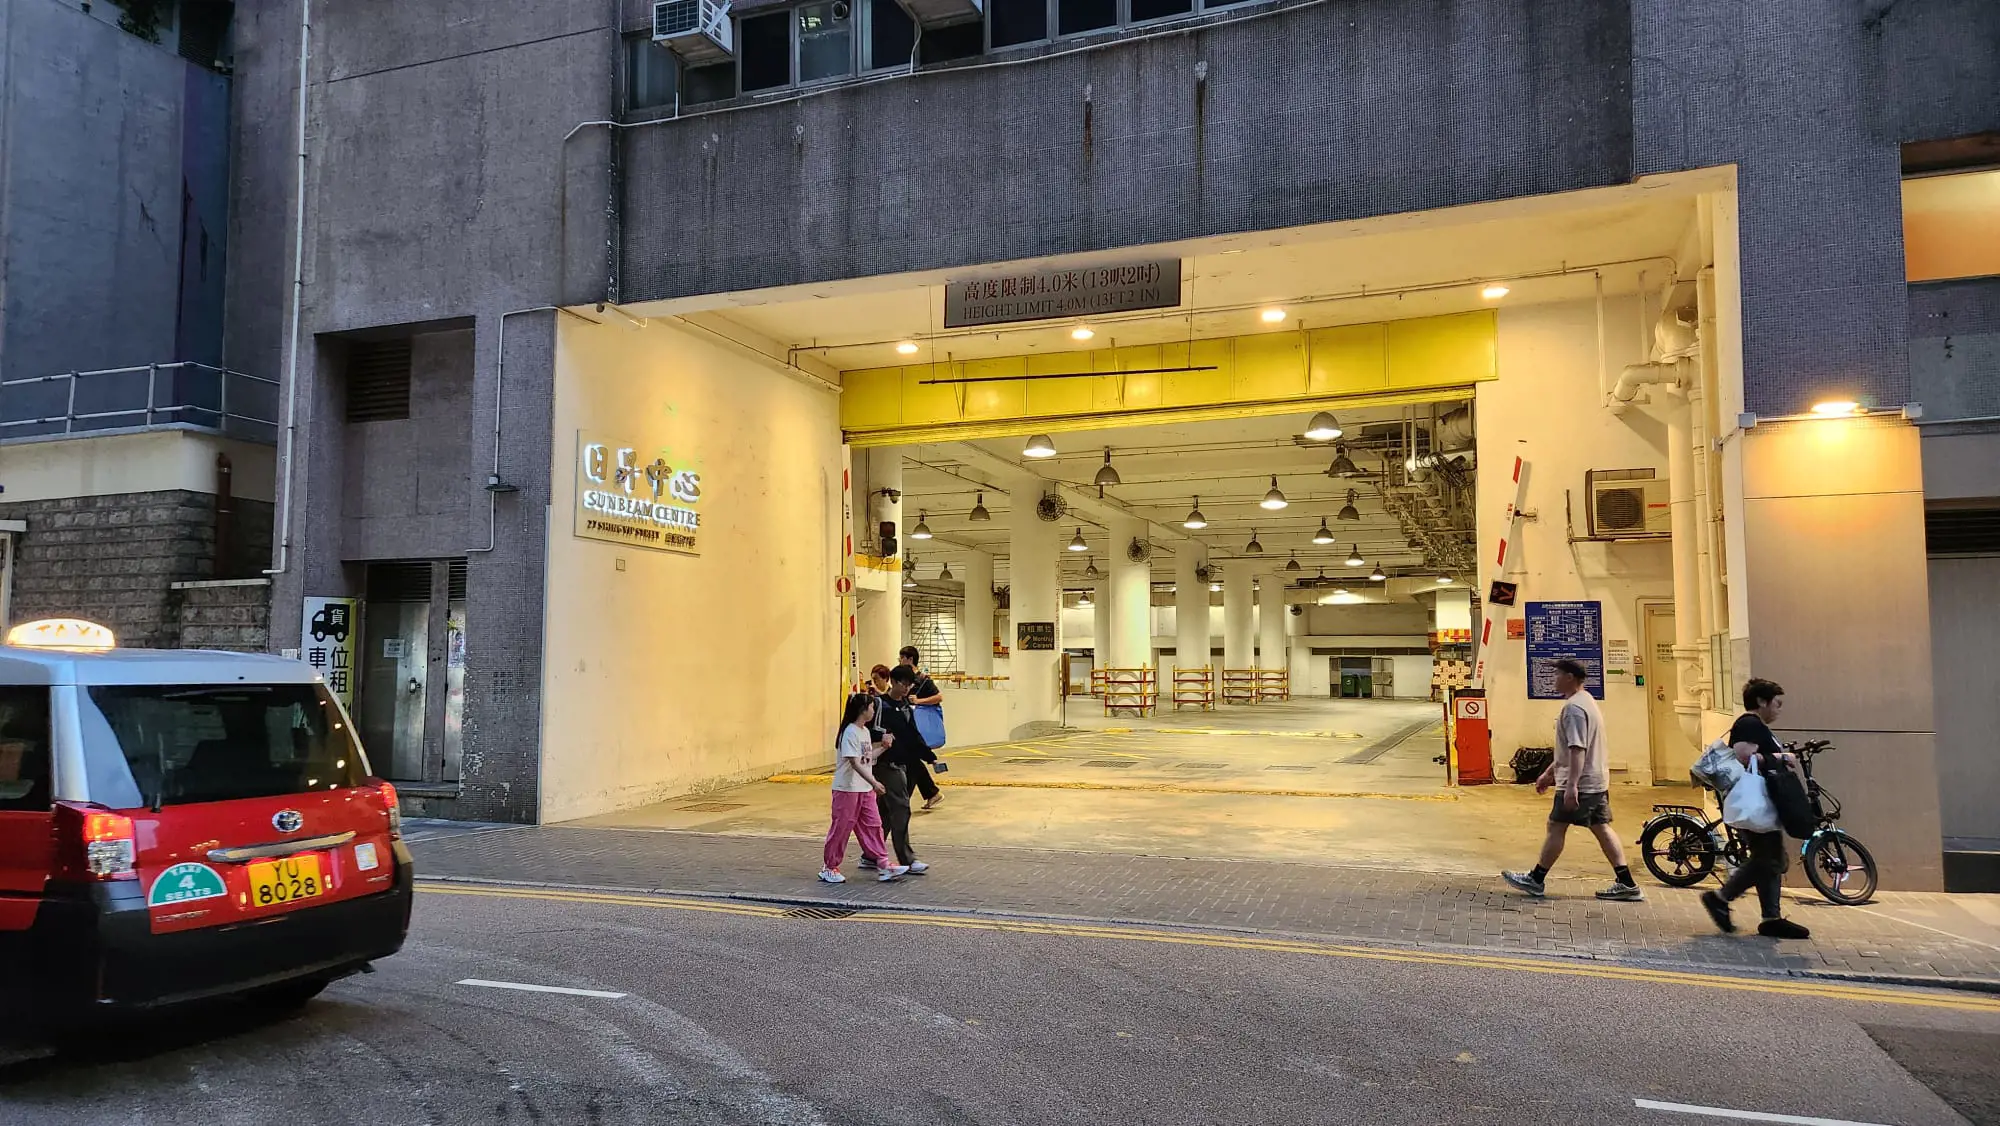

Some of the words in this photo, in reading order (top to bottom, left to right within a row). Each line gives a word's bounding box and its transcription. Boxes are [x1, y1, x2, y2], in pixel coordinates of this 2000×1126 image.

[963, 302, 1014, 320] HEIGHT
[1016, 300, 1053, 316] LIMIT
[1056, 297, 1087, 313] 4.0M
[1140, 288, 1160, 303] IN)
[584, 490, 654, 519] SUNBEAM
[654, 503, 701, 528] CENTRE
[330, 608, 345, 625] 貨
[309, 646, 349, 669] 車位
[169, 865, 202, 876] TAXI
[178, 875, 196, 888] 4
[272, 860, 300, 882] YU
[164, 887, 212, 902] SEATS
[258, 877, 317, 904] 8028
